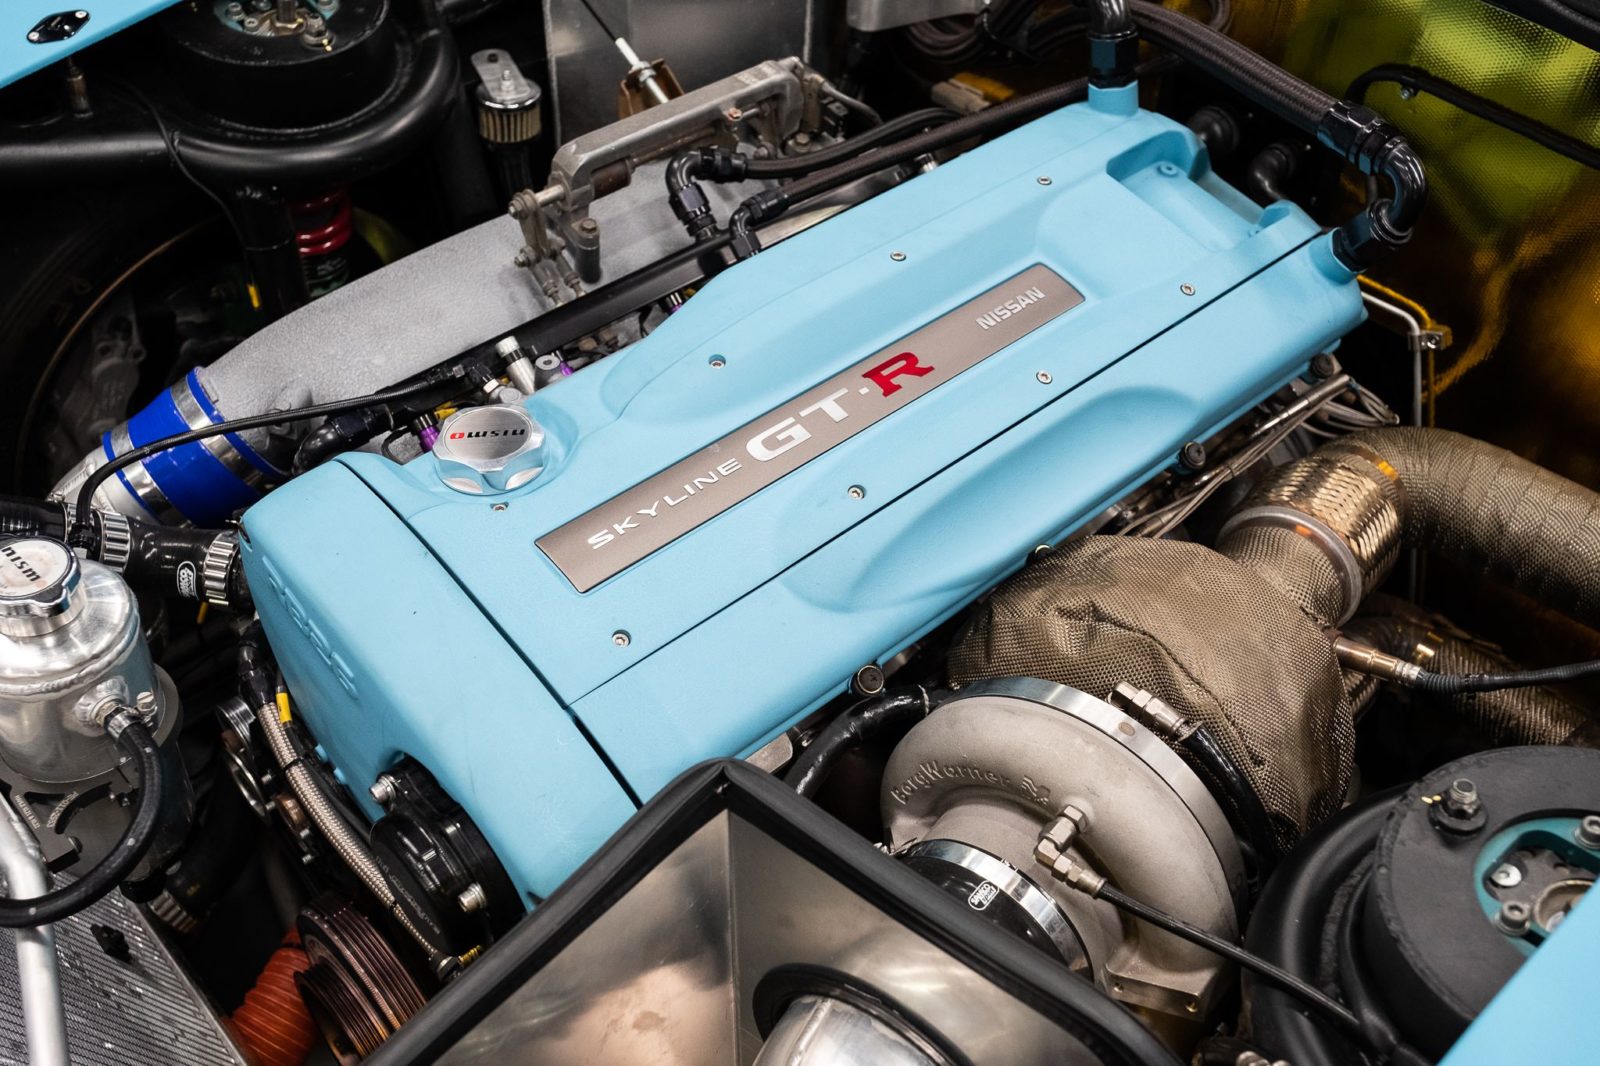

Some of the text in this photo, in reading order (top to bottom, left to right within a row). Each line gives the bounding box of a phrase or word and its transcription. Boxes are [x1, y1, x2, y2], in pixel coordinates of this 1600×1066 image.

[975, 286, 1046, 330] NISSAN
[449, 428, 525, 440] nismo
[587, 457, 743, 550] SKYLINE
